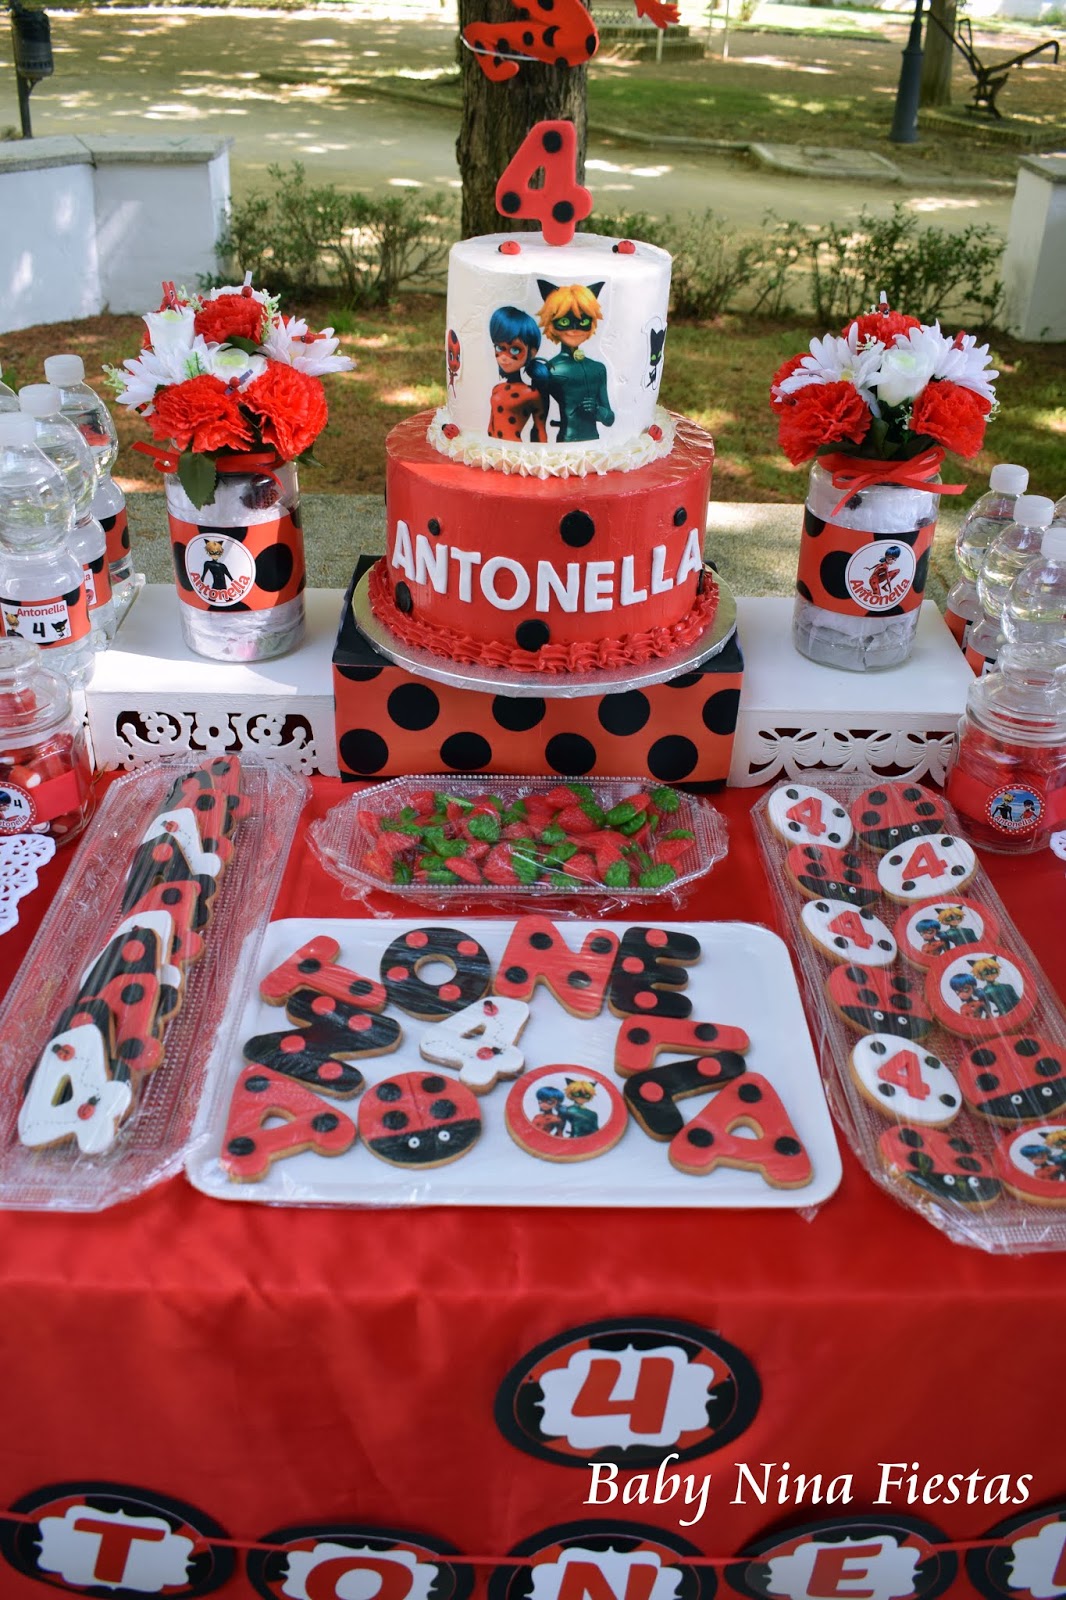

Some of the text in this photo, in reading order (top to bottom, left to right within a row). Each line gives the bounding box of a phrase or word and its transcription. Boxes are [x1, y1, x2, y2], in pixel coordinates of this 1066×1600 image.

[495, 119, 593, 246] 4
[391, 519, 702, 613] ANTONELLA
[190, 572, 251, 601] Antonella
[850, 579, 910, 605] Antonella
[16, 604, 66, 617] Antonella
[33, 622, 46, 638] 4
[0, 815, 28, 829] tonella
[13, 799, 23, 809] 4
[786, 796, 827, 837] 4
[995, 815, 1034, 829] Antonella
[902, 842, 949, 880] 4
[828, 910, 874, 950] 4
[419, 996, 530, 1096] 4
[18, 1023, 132, 1154] 4
[877, 1049, 932, 1101] 4
[571, 1356, 675, 1435] 4
